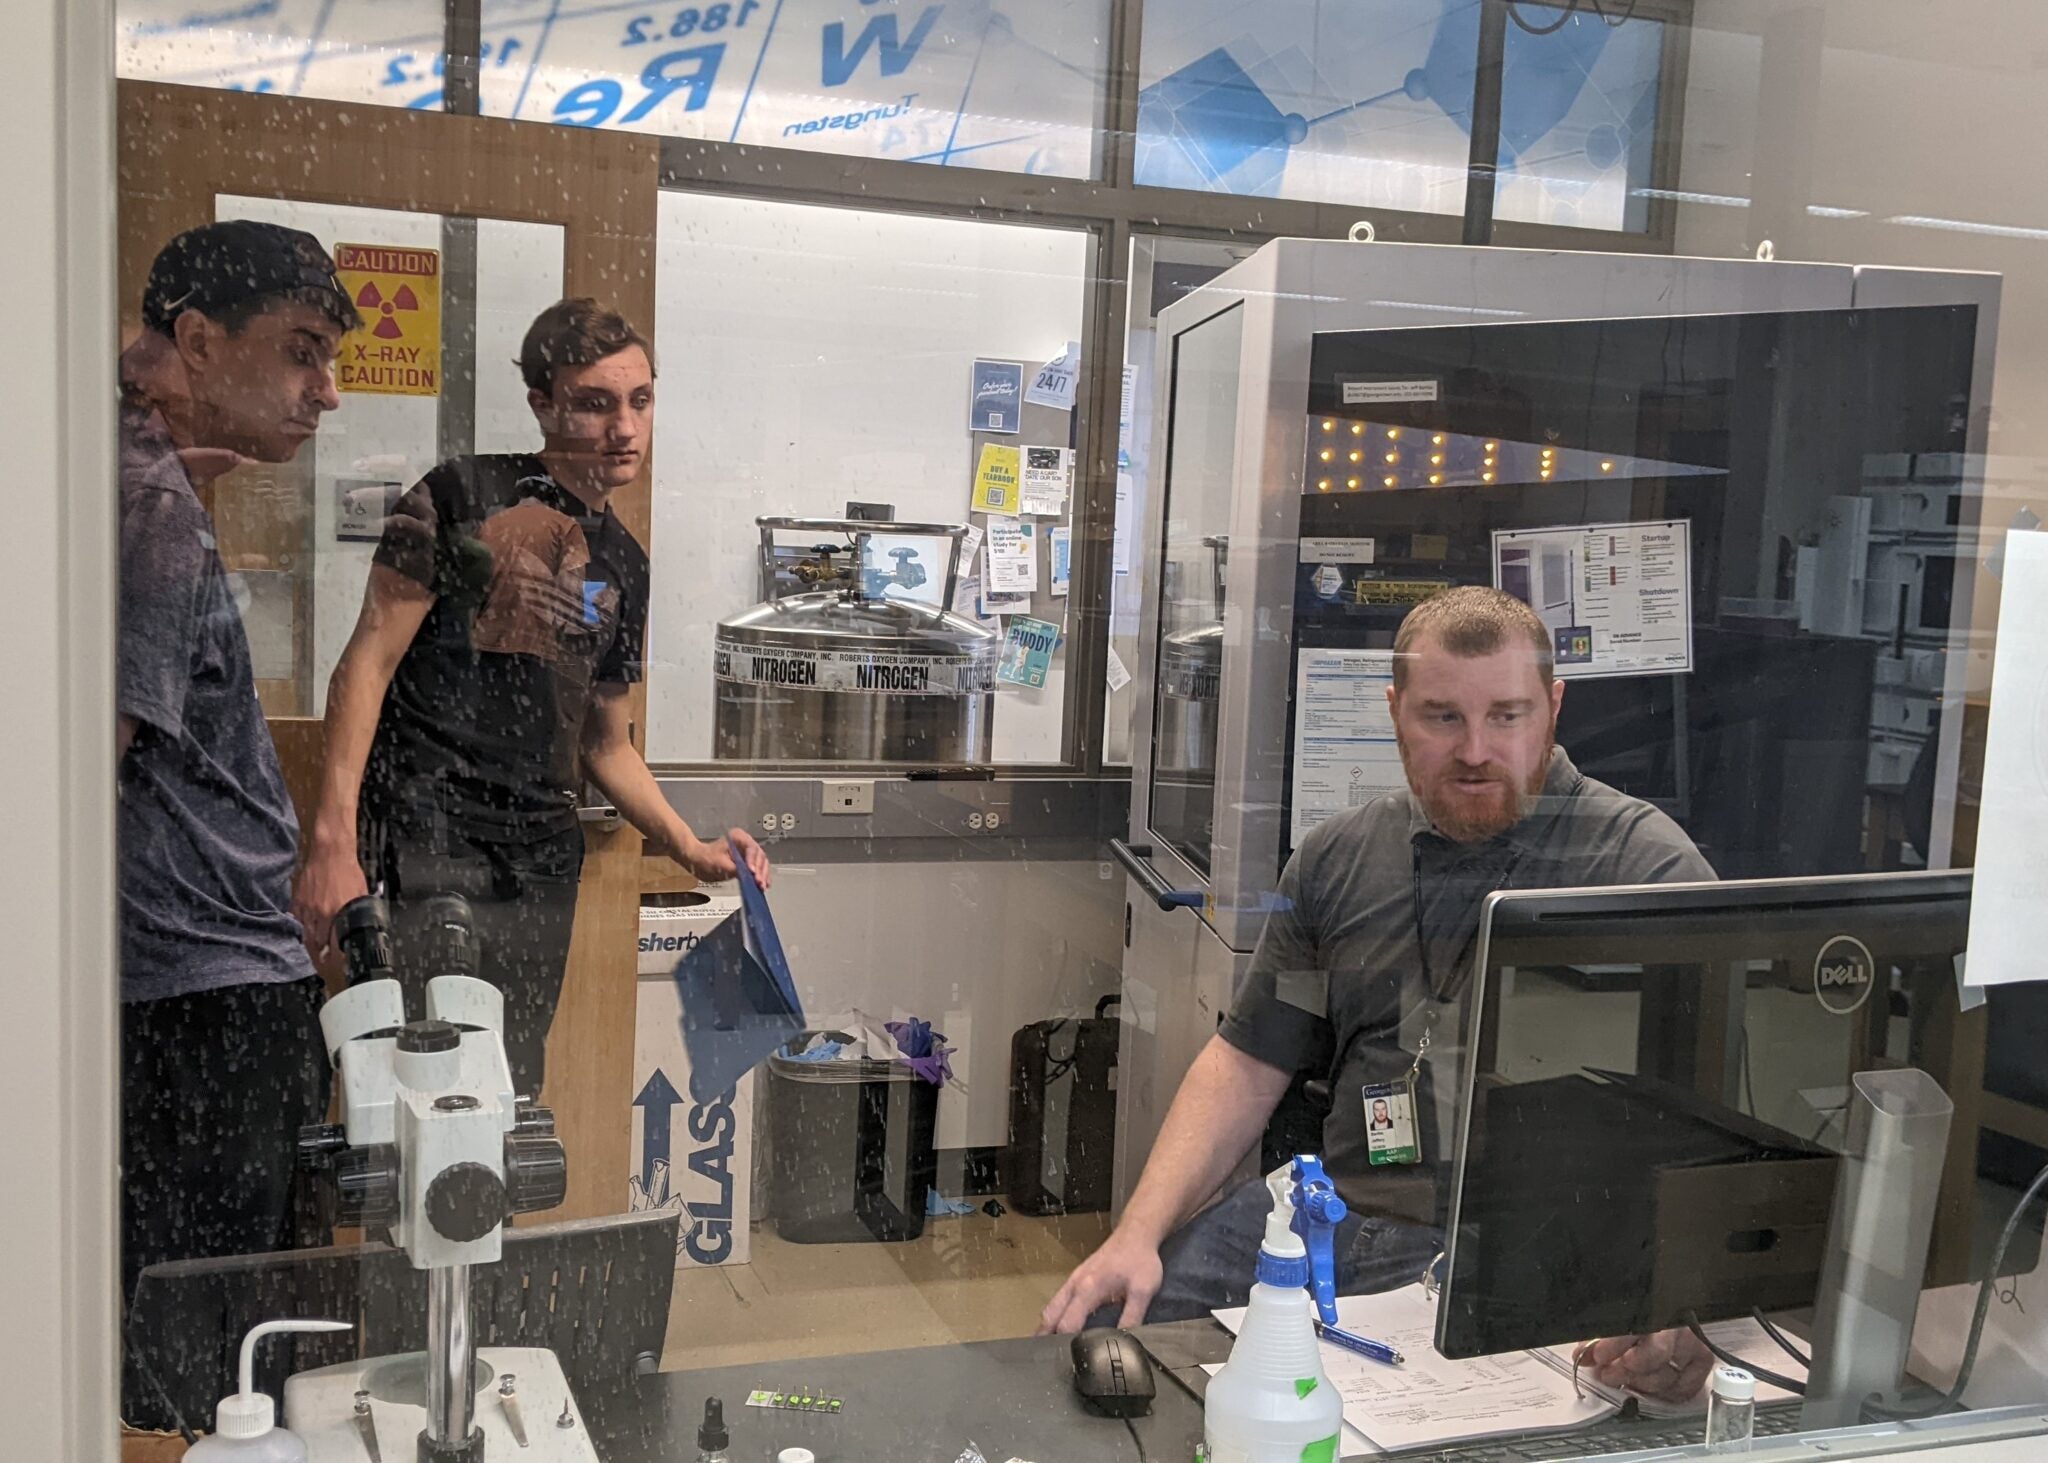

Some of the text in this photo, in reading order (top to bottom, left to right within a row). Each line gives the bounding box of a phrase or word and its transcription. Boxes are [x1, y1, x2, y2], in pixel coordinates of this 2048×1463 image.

[341, 250, 434, 273] CAUTION
[354, 345, 420, 363] X-RAY
[341, 365, 434, 388] CAUTION
[1036, 373, 1067, 393] 24/7
[983, 472, 1015, 484] YEARBOOK
[1641, 534, 1670, 543] Startup
[1639, 587, 1679, 597] Shutdown
[1012, 628, 1053, 654] BUDDY
[741, 646, 762, 656] ROBERTS
[763, 648, 785, 657] OXYGEN
[786, 650, 818, 660] COMPANY,
[820, 652, 834, 660] INC.
[840, 653, 870, 663] ROBERTS
[871, 655, 898, 664] OXYGEN
[900, 656, 931, 666] COMPANY,
[752, 656, 816, 685] NITROGEN
[856, 664, 929, 690] NITROGEN
[1821, 965, 1867, 986] DELL
